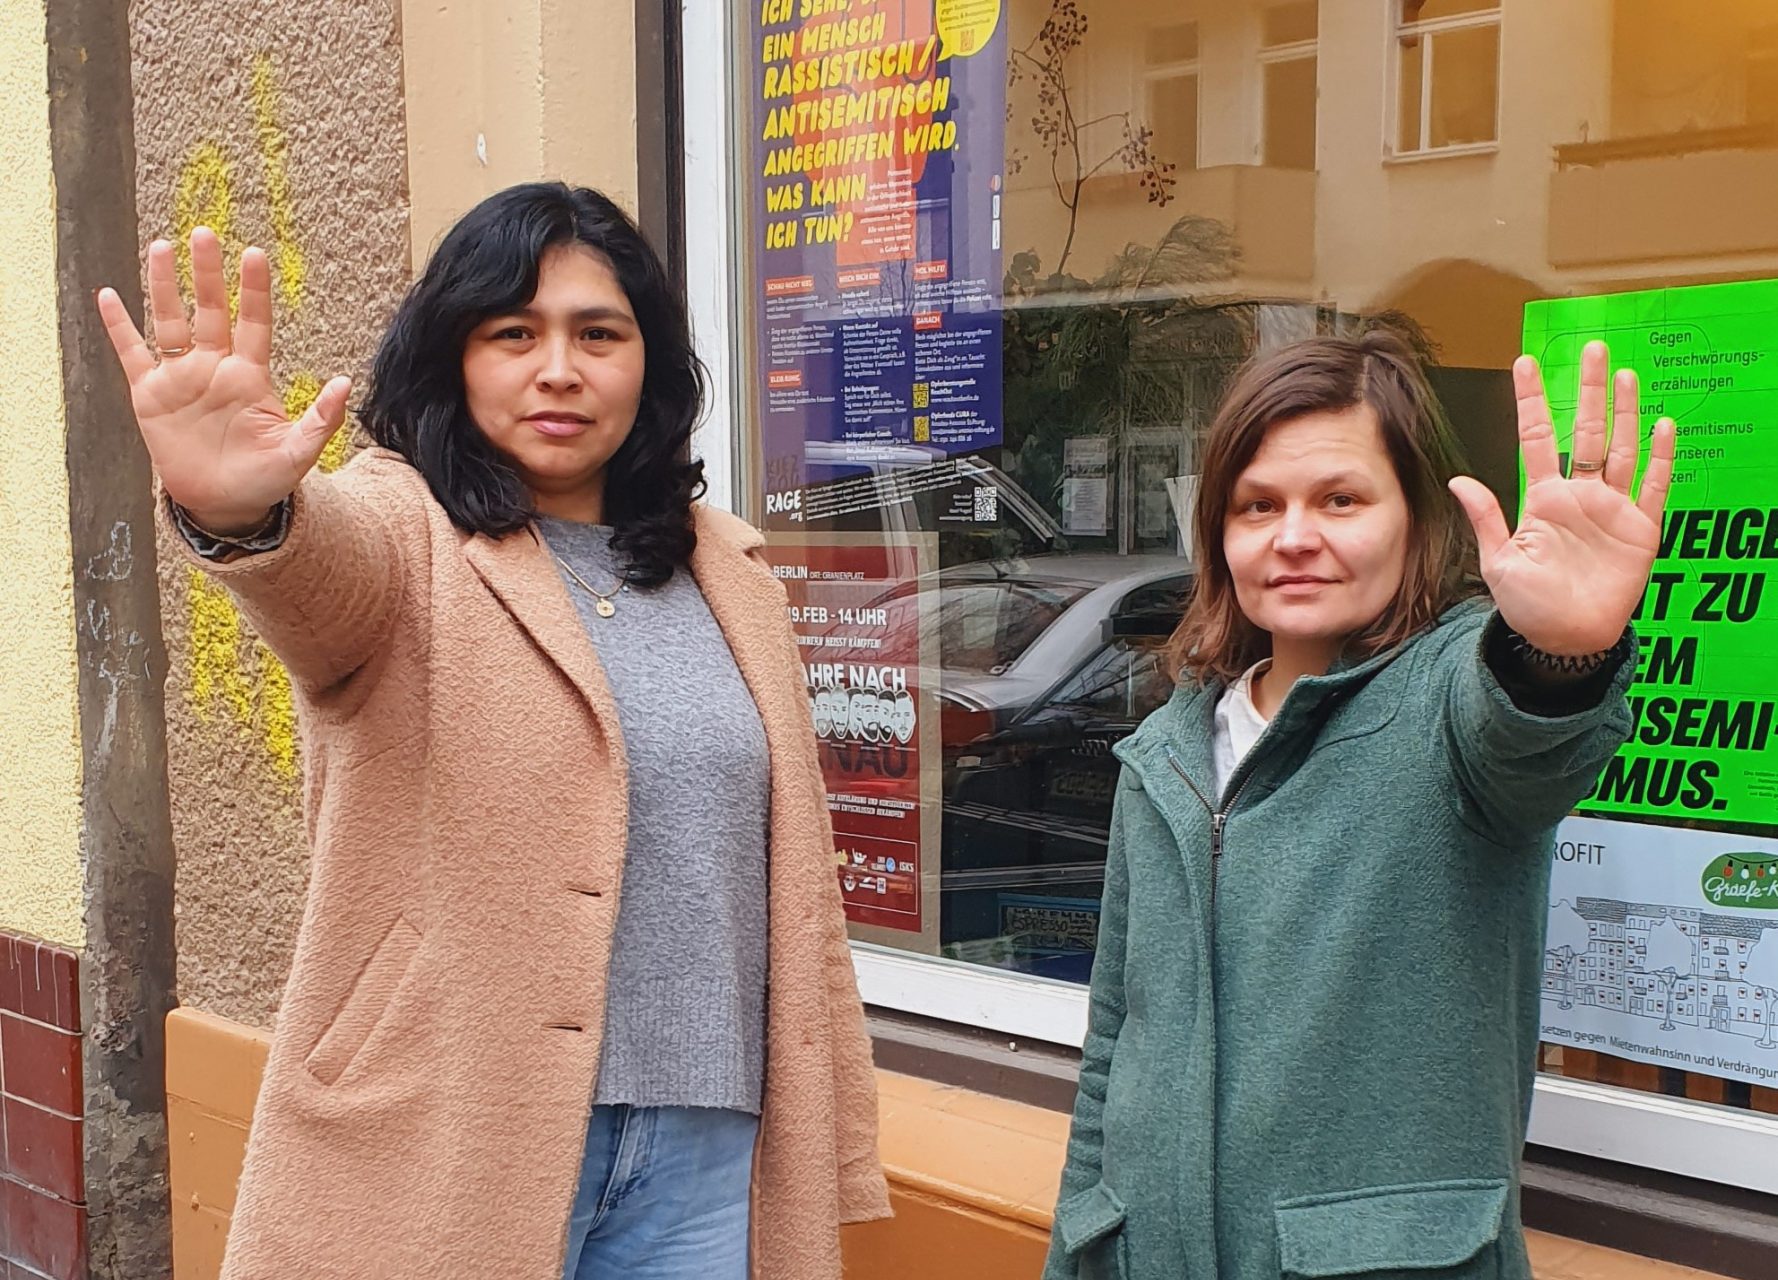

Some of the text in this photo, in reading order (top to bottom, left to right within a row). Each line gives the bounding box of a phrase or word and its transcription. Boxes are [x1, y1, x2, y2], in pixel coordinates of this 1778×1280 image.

[762, 11, 886, 64] EIN MENSCH
[763, 39, 916, 100] RASSISTISCH
[762, 77, 950, 141] ANTISEMITISCH
[763, 121, 959, 177] ANGEGRIFFEN WIRD.
[766, 173, 866, 213] WAS KANN
[766, 222, 798, 250] ICH
[804, 211, 853, 246] TUN?
[1650, 331, 1692, 347] Gegen
[1653, 351, 1765, 368] Verschwörungs-
[1651, 375, 1734, 392] erzählungen
[1639, 400, 1664, 415] und
[766, 489, 802, 515] RAGE
[773, 565, 808, 579] BERLIN
[838, 608, 852, 625] 14
[856, 608, 887, 626] UHR
[1691, 572, 1766, 623] ZU
[850, 665, 906, 692] NACH
[1580, 755, 1728, 811] MUS.
[1542, 1025, 1572, 1039] setzen
[1573, 1031, 1606, 1044] gegen
[1609, 1036, 1691, 1063] Mietenwahnsinn
[1694, 1055, 1715, 1067] und
